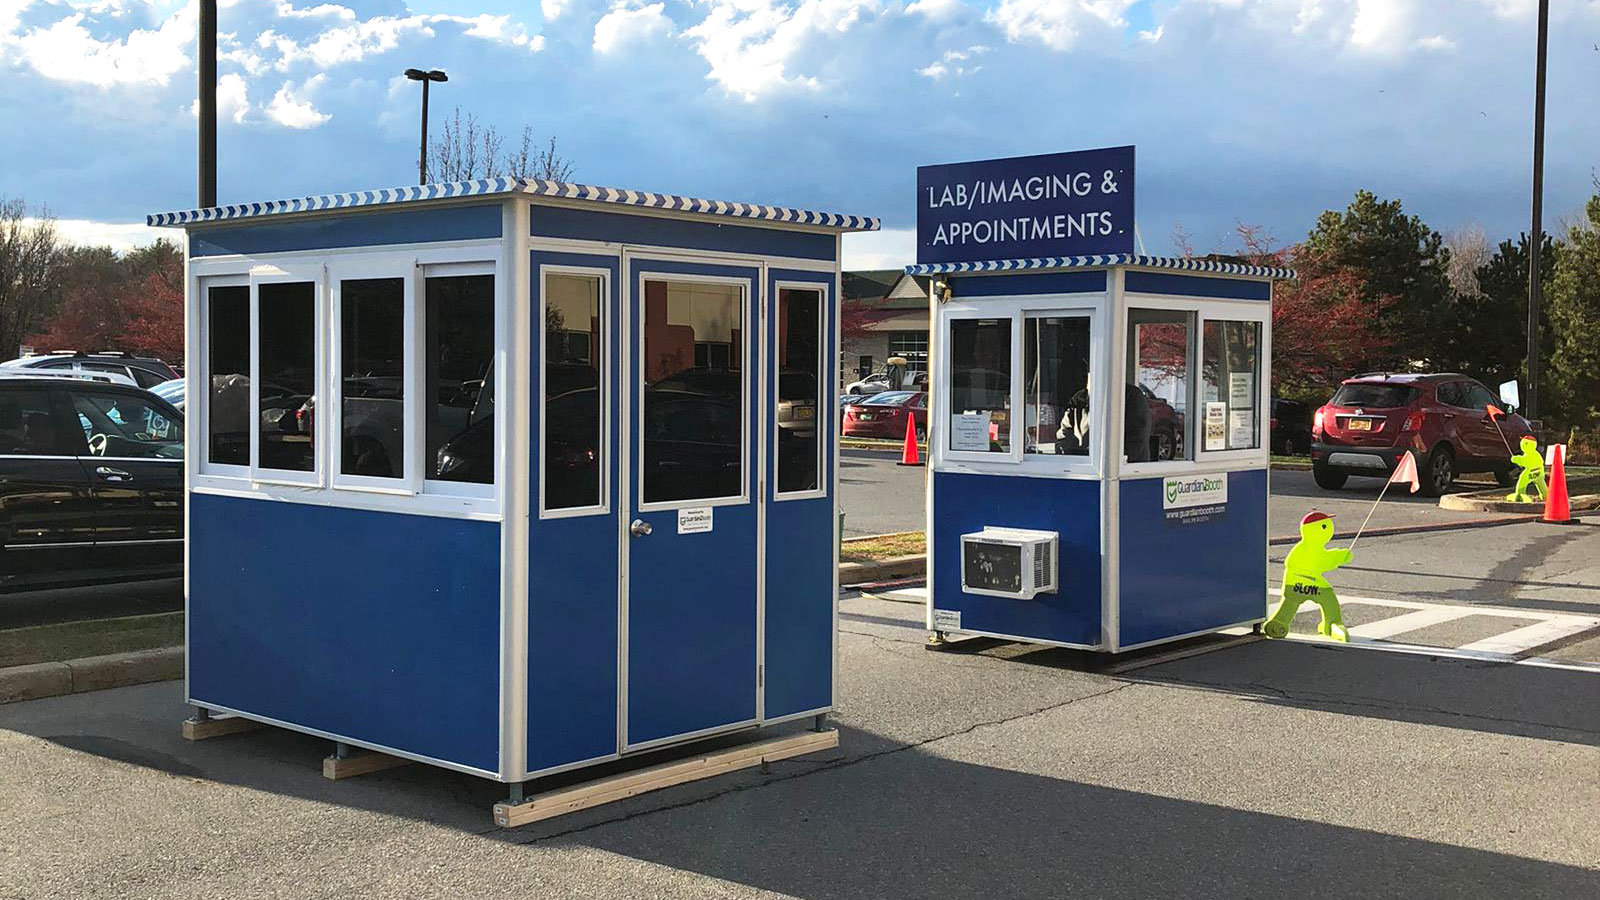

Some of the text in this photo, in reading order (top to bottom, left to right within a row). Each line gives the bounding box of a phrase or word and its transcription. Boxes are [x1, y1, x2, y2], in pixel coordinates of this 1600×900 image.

[929, 169, 1119, 210] LAB/IMAGING &
[932, 211, 1113, 246] APPOINTMENTS
